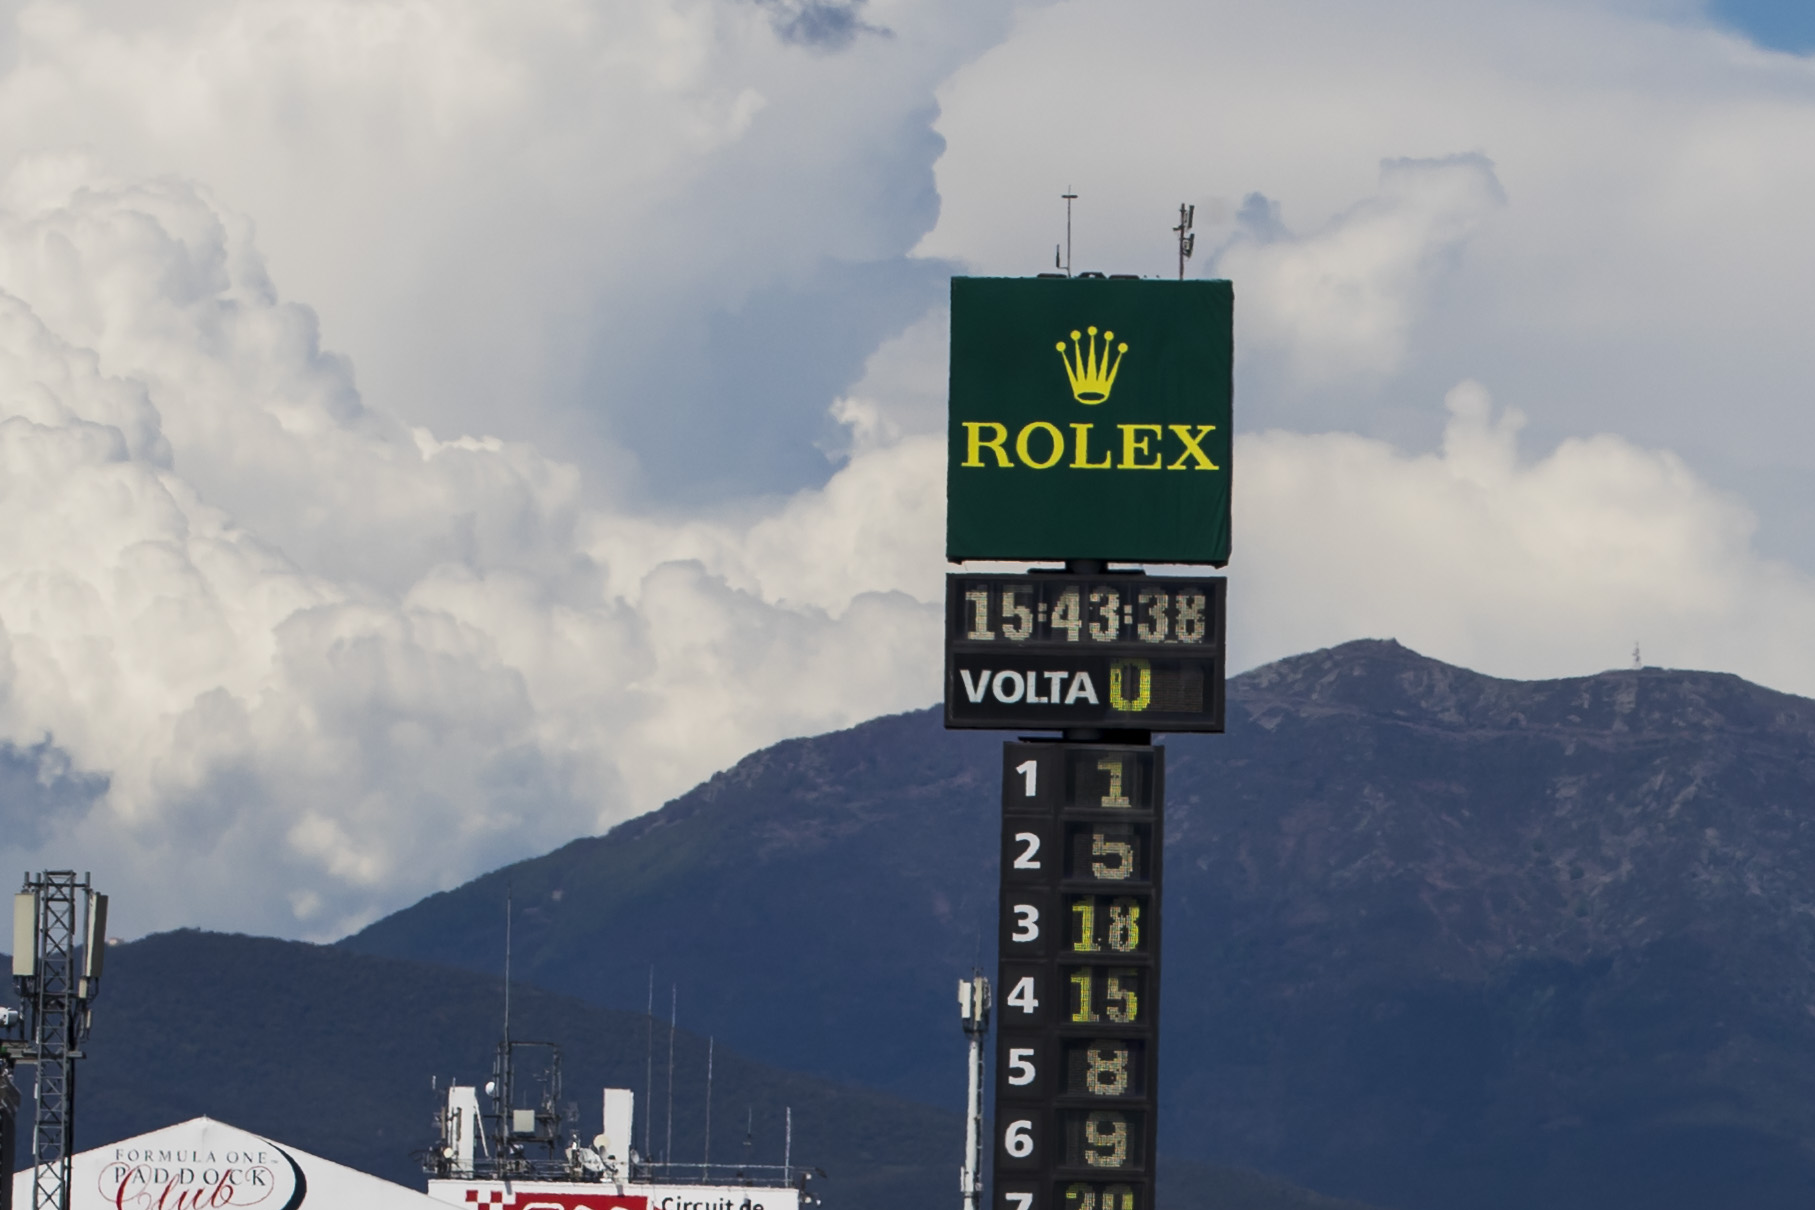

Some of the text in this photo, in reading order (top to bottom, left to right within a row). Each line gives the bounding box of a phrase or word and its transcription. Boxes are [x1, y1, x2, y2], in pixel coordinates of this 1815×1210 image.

[961, 421, 1219, 471] ROLEX
[965, 588, 1206, 643] 15:43:38
[959, 668, 1099, 704] VOLTA
[1016, 760, 1037, 797] 1
[1013, 832, 1041, 869] 2
[1012, 904, 1039, 942] 3
[1008, 976, 1039, 1014] 4
[1008, 1048, 1036, 1086] 5
[115, 1148, 268, 1164] FORMULA ONE
[1004, 1119, 1034, 1157] 6
[114, 1166, 267, 1186] PADDOCK
